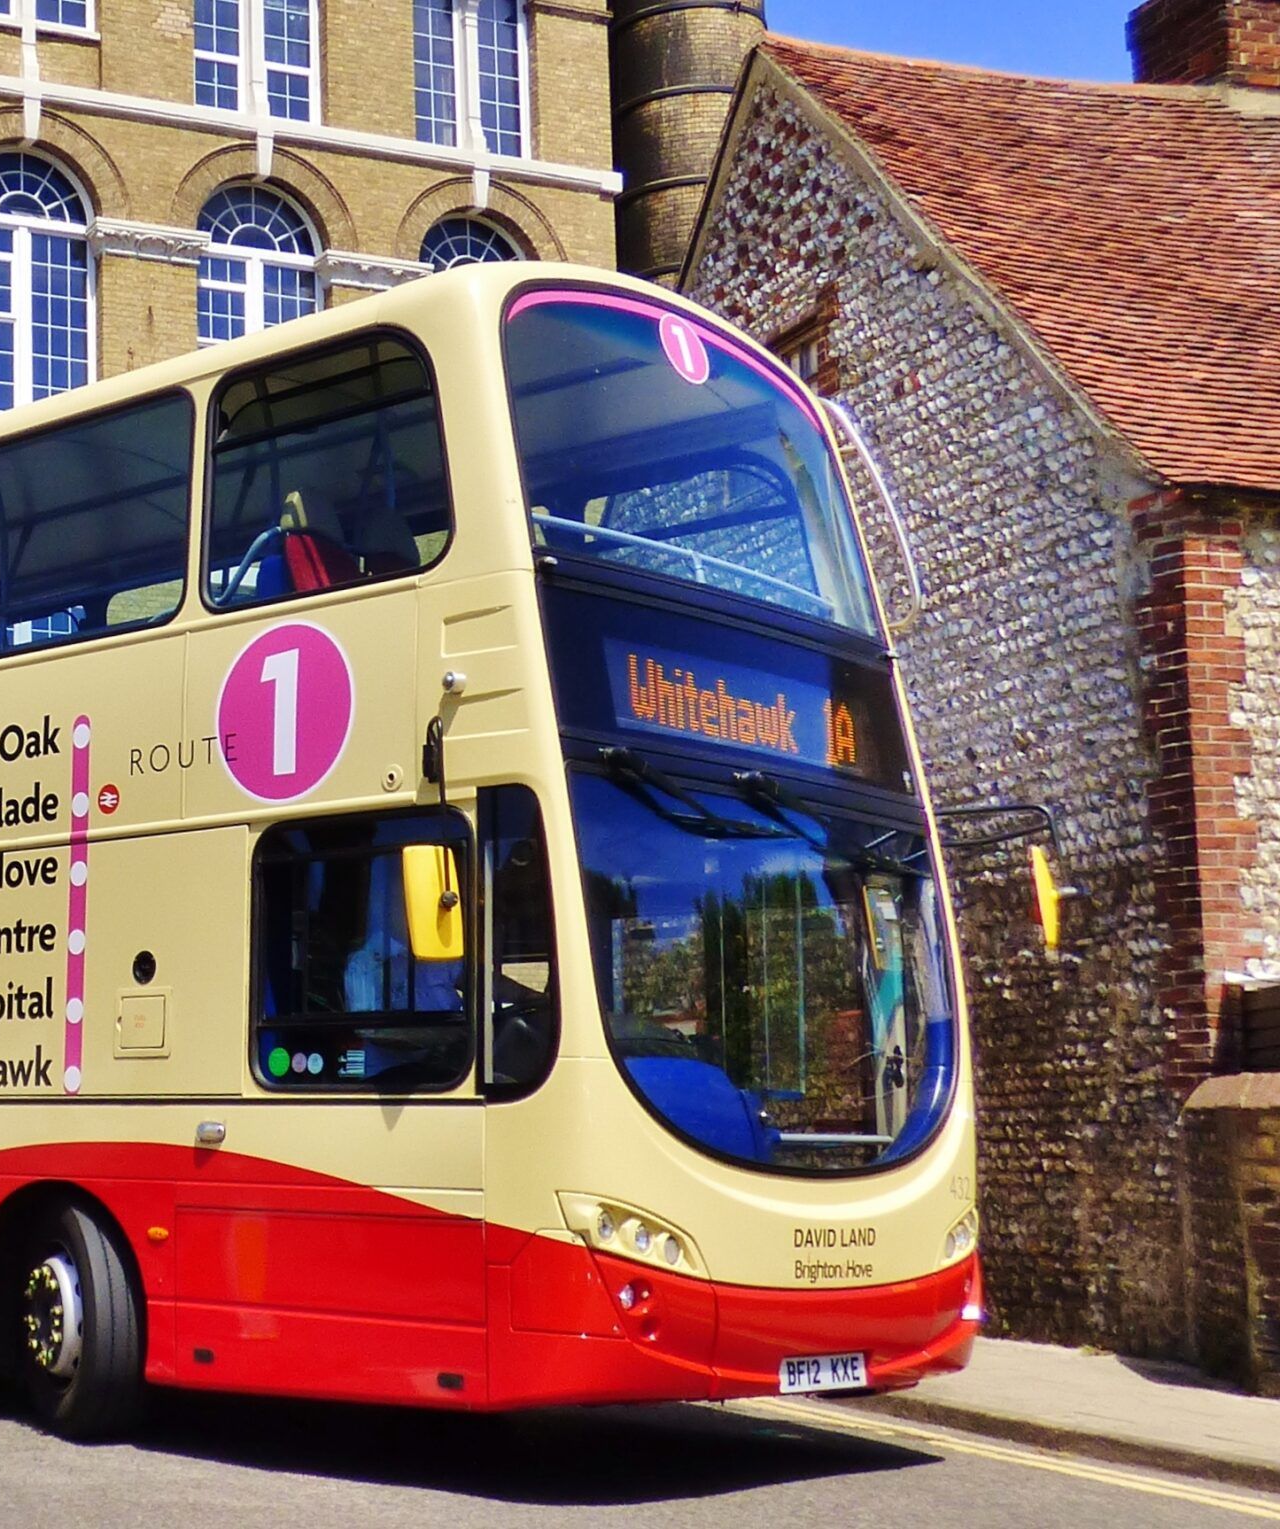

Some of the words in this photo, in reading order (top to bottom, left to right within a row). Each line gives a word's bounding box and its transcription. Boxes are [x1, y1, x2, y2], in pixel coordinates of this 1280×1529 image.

[671, 324, 694, 373] 1
[260, 647, 300, 776] 1
[628, 654, 799, 754] Whitehawk
[824, 698, 856, 767] 1A
[130, 733, 237, 776] ROUTE
[794, 1229, 837, 1248] DAVID
[841, 1228, 876, 1247] LAND
[795, 1260, 842, 1283] Brighton
[846, 1259, 873, 1278] Hove
[786, 1359, 821, 1386] BF12
[830, 1357, 860, 1382] KXE
